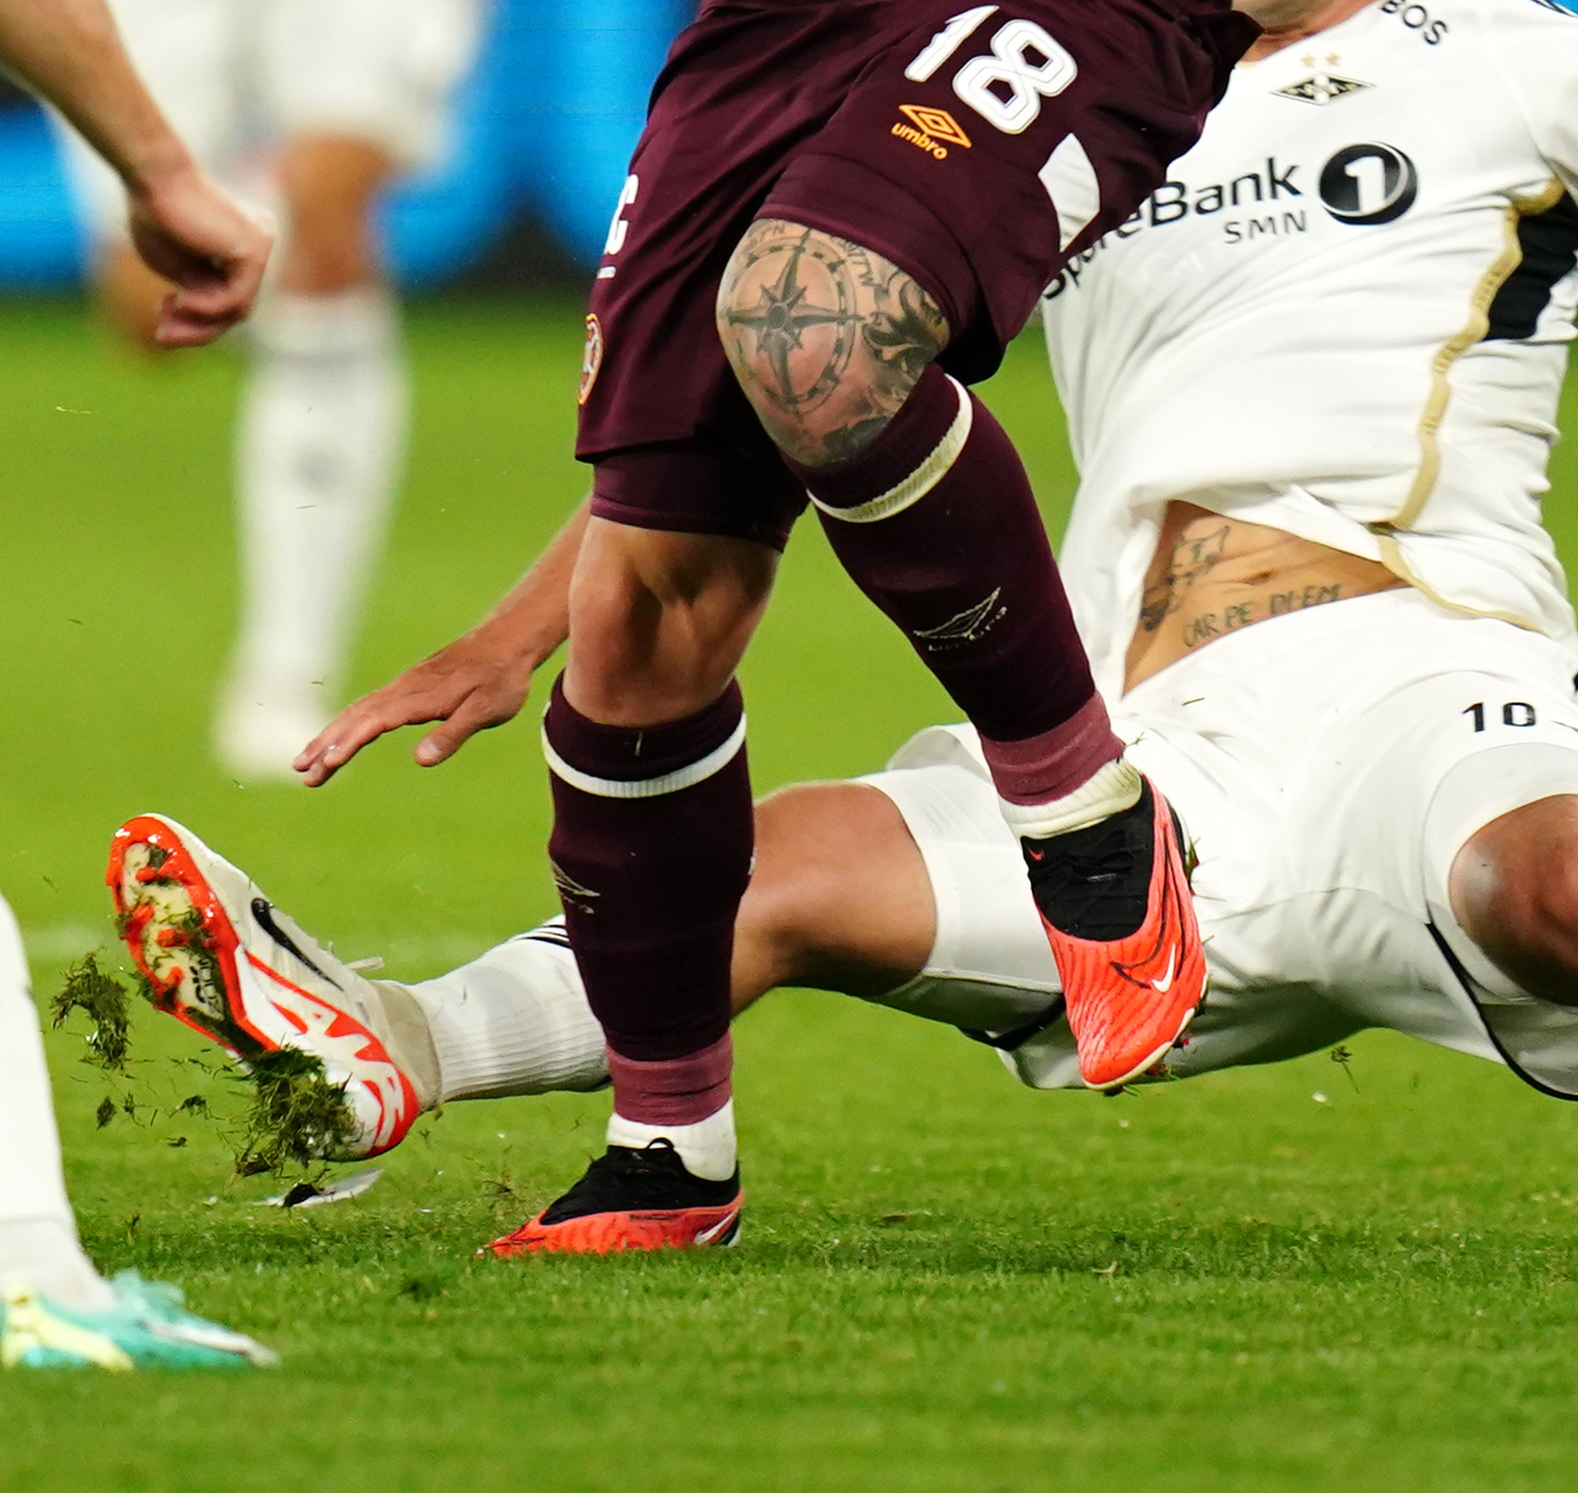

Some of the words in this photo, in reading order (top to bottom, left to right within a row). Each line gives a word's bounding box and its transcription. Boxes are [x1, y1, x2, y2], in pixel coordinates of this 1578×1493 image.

[904, 4, 1078, 135] 18
[891, 122, 948, 160] umbro
[1223, 209, 1307, 245] SMN
[1462, 701, 1538, 733] 10
